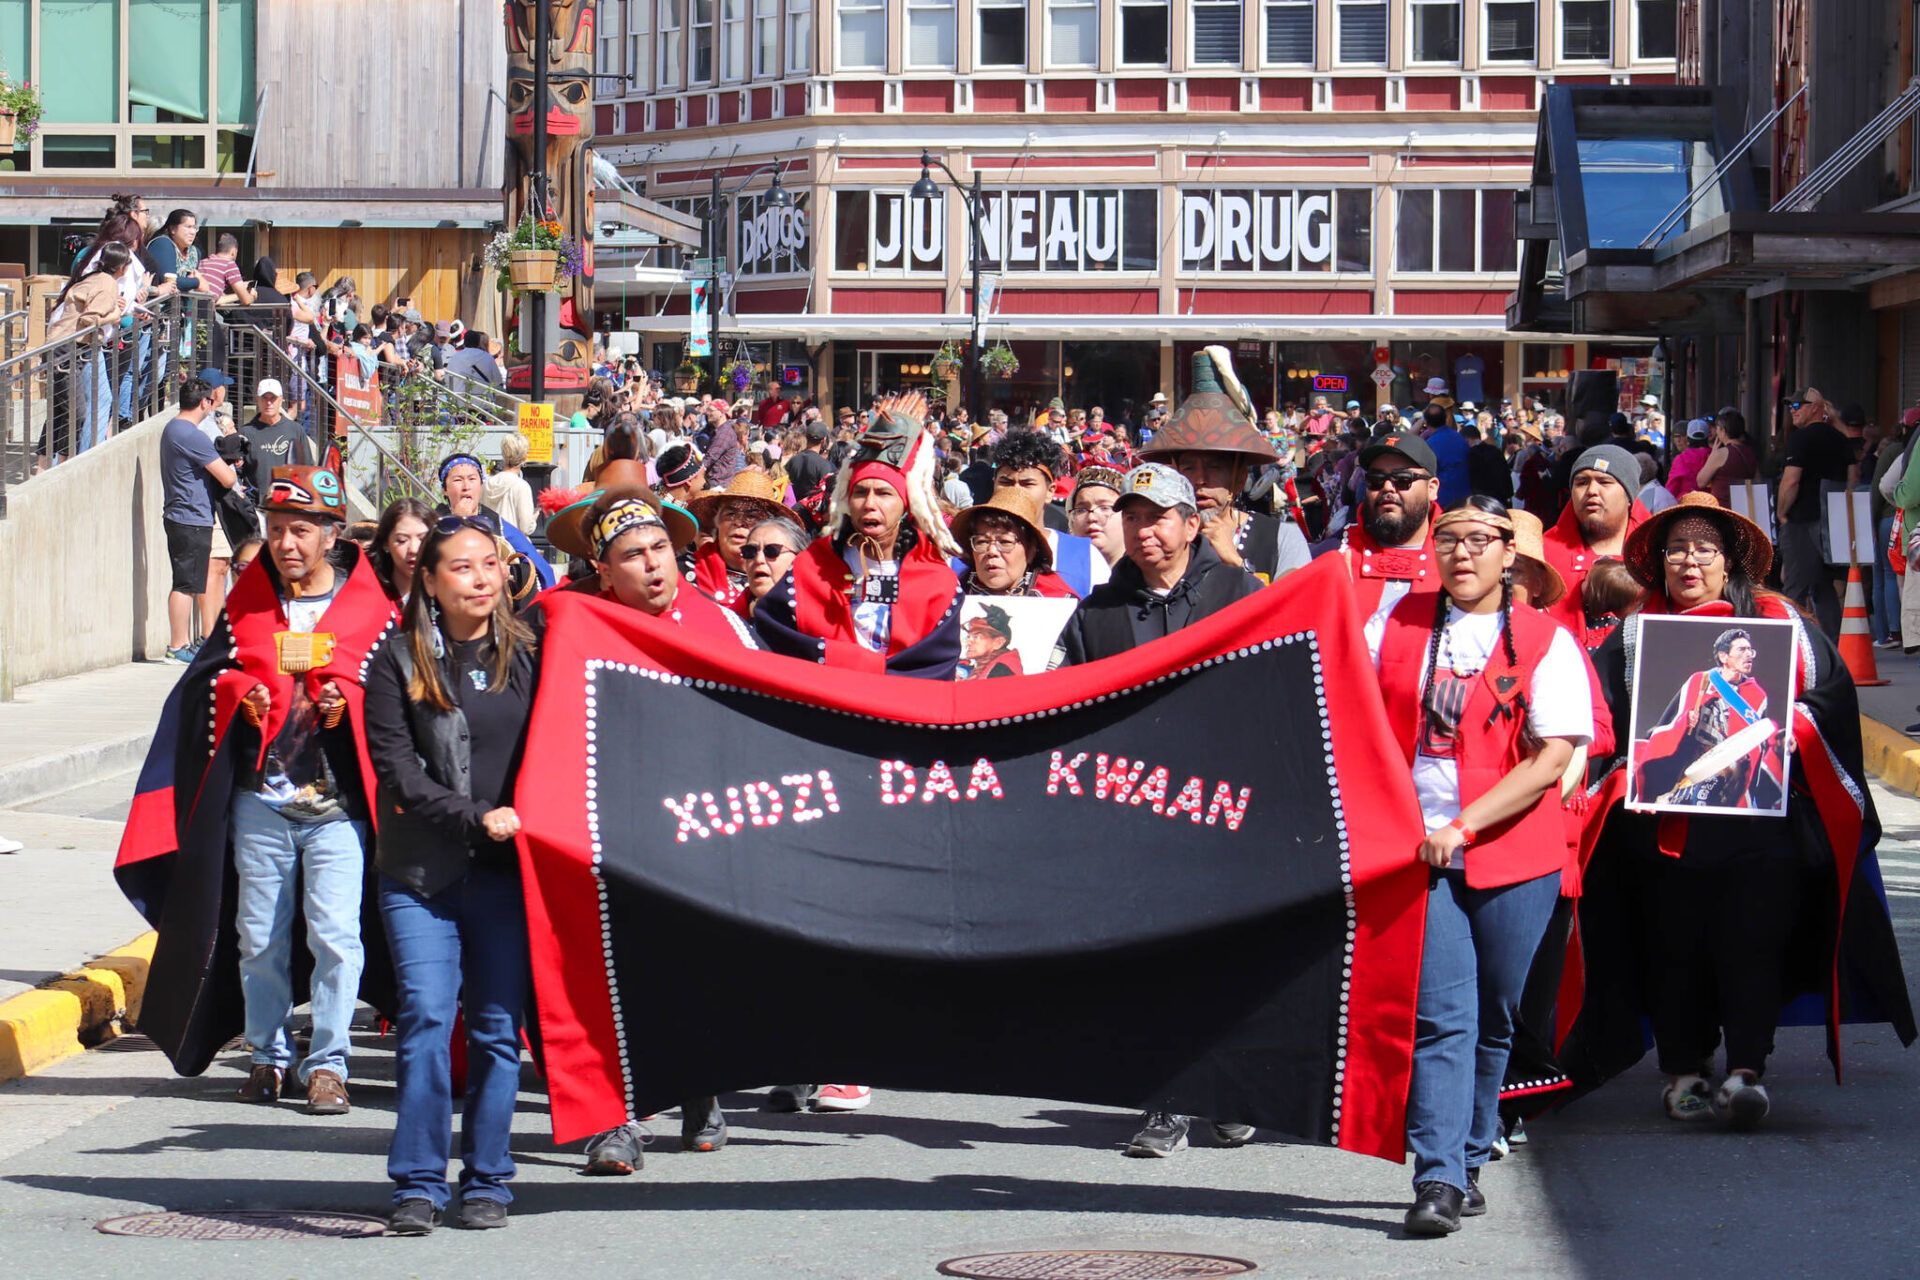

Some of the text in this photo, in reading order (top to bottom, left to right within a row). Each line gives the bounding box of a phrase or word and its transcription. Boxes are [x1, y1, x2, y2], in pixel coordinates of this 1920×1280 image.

[875, 194, 1332, 262] JUNEAU DRUG
[742, 206, 806, 264] DRUGS
[1375, 369, 1391, 377] FDC
[1315, 377, 1346, 390] OPEN
[530, 405, 540, 417] NO
[520, 418, 550, 429] PARKING
[664, 751, 1252, 843] XUDZI DAA KWAAN
